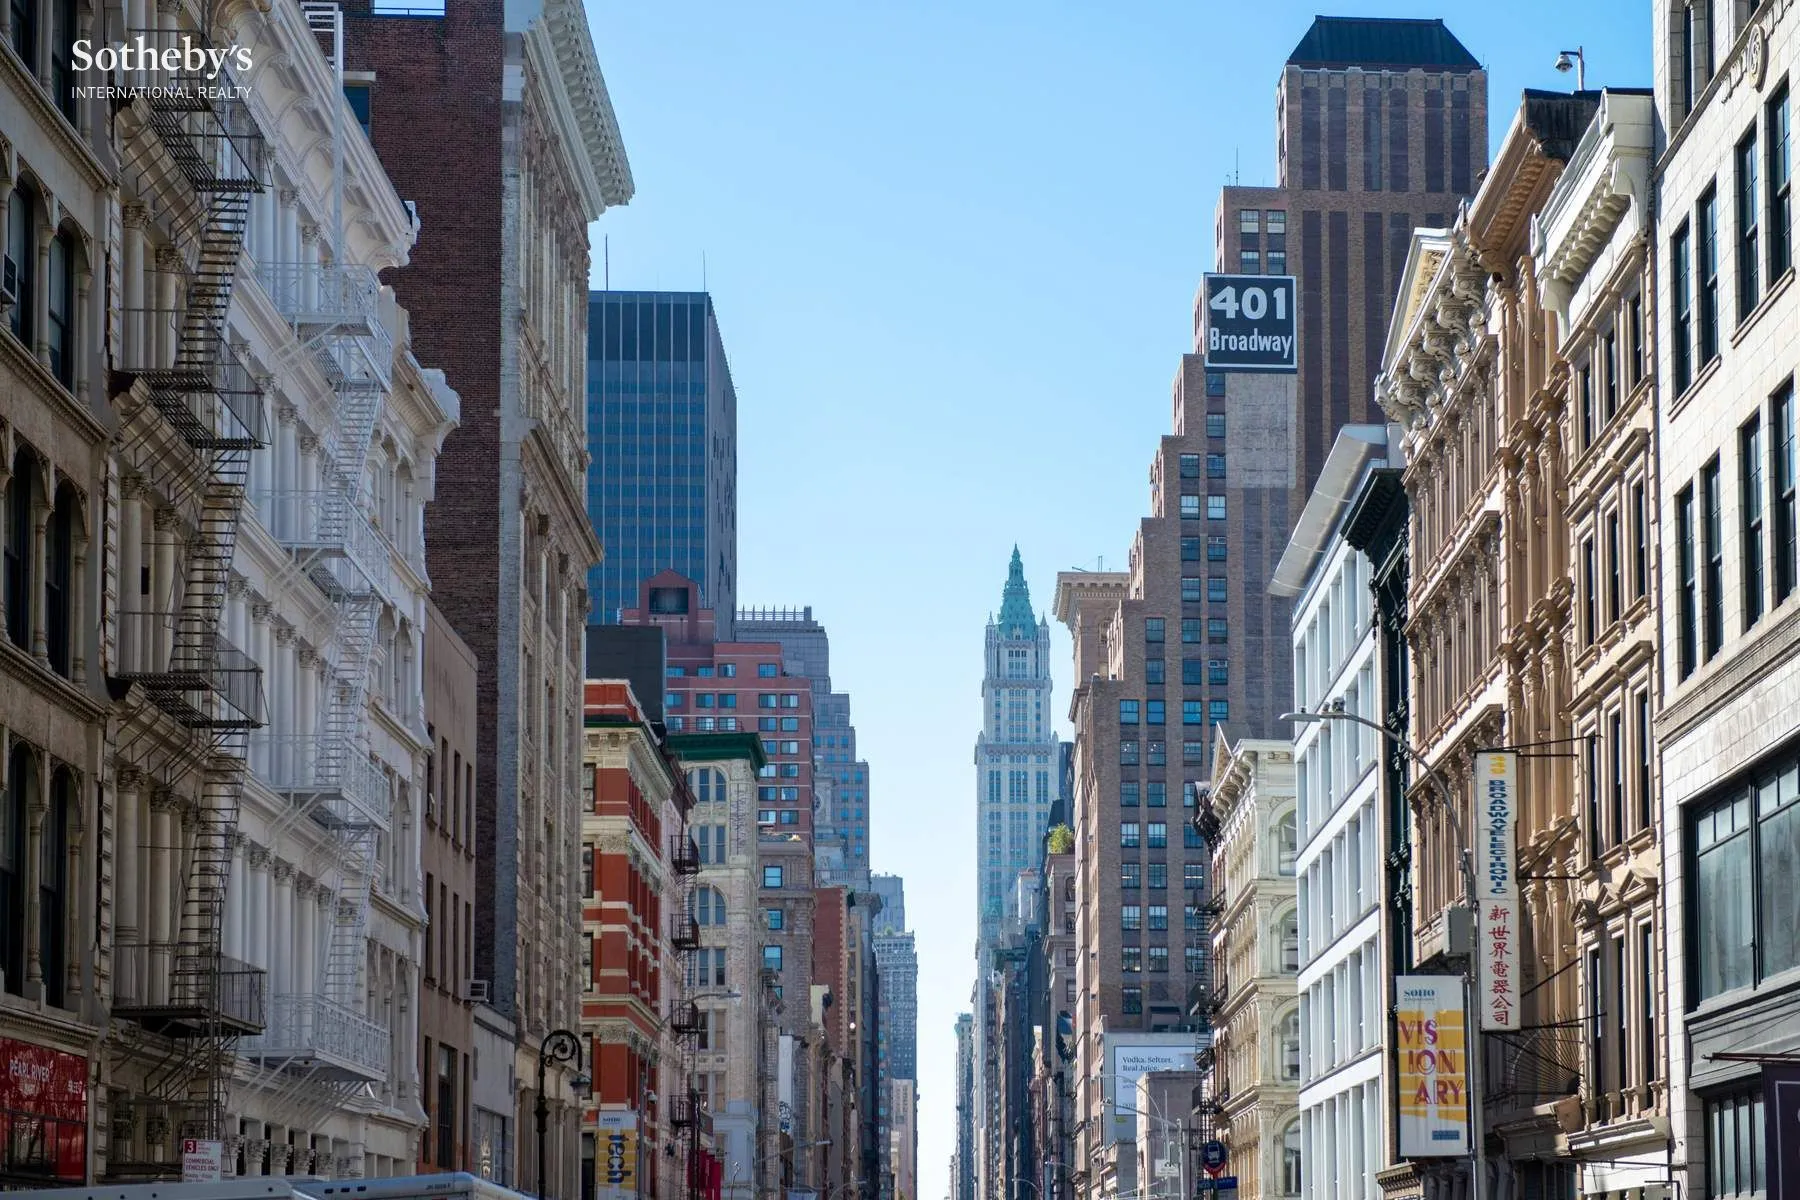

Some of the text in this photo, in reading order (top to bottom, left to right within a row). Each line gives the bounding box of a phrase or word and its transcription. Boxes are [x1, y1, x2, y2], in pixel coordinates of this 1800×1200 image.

[1209, 286, 1286, 320] 401
[1209, 327, 1293, 359] Broadway
[1488, 905, 1513, 1026] 新世界電器公司
[1400, 1019, 1438, 1045] VIS
[9, 1059, 50, 1083] PEARL RIVER
[1408, 1050, 1456, 1075] ION
[1414, 1079, 1464, 1105] ARY
[187, 1141, 194, 1153] 3
[608, 1134, 632, 1183] tech
